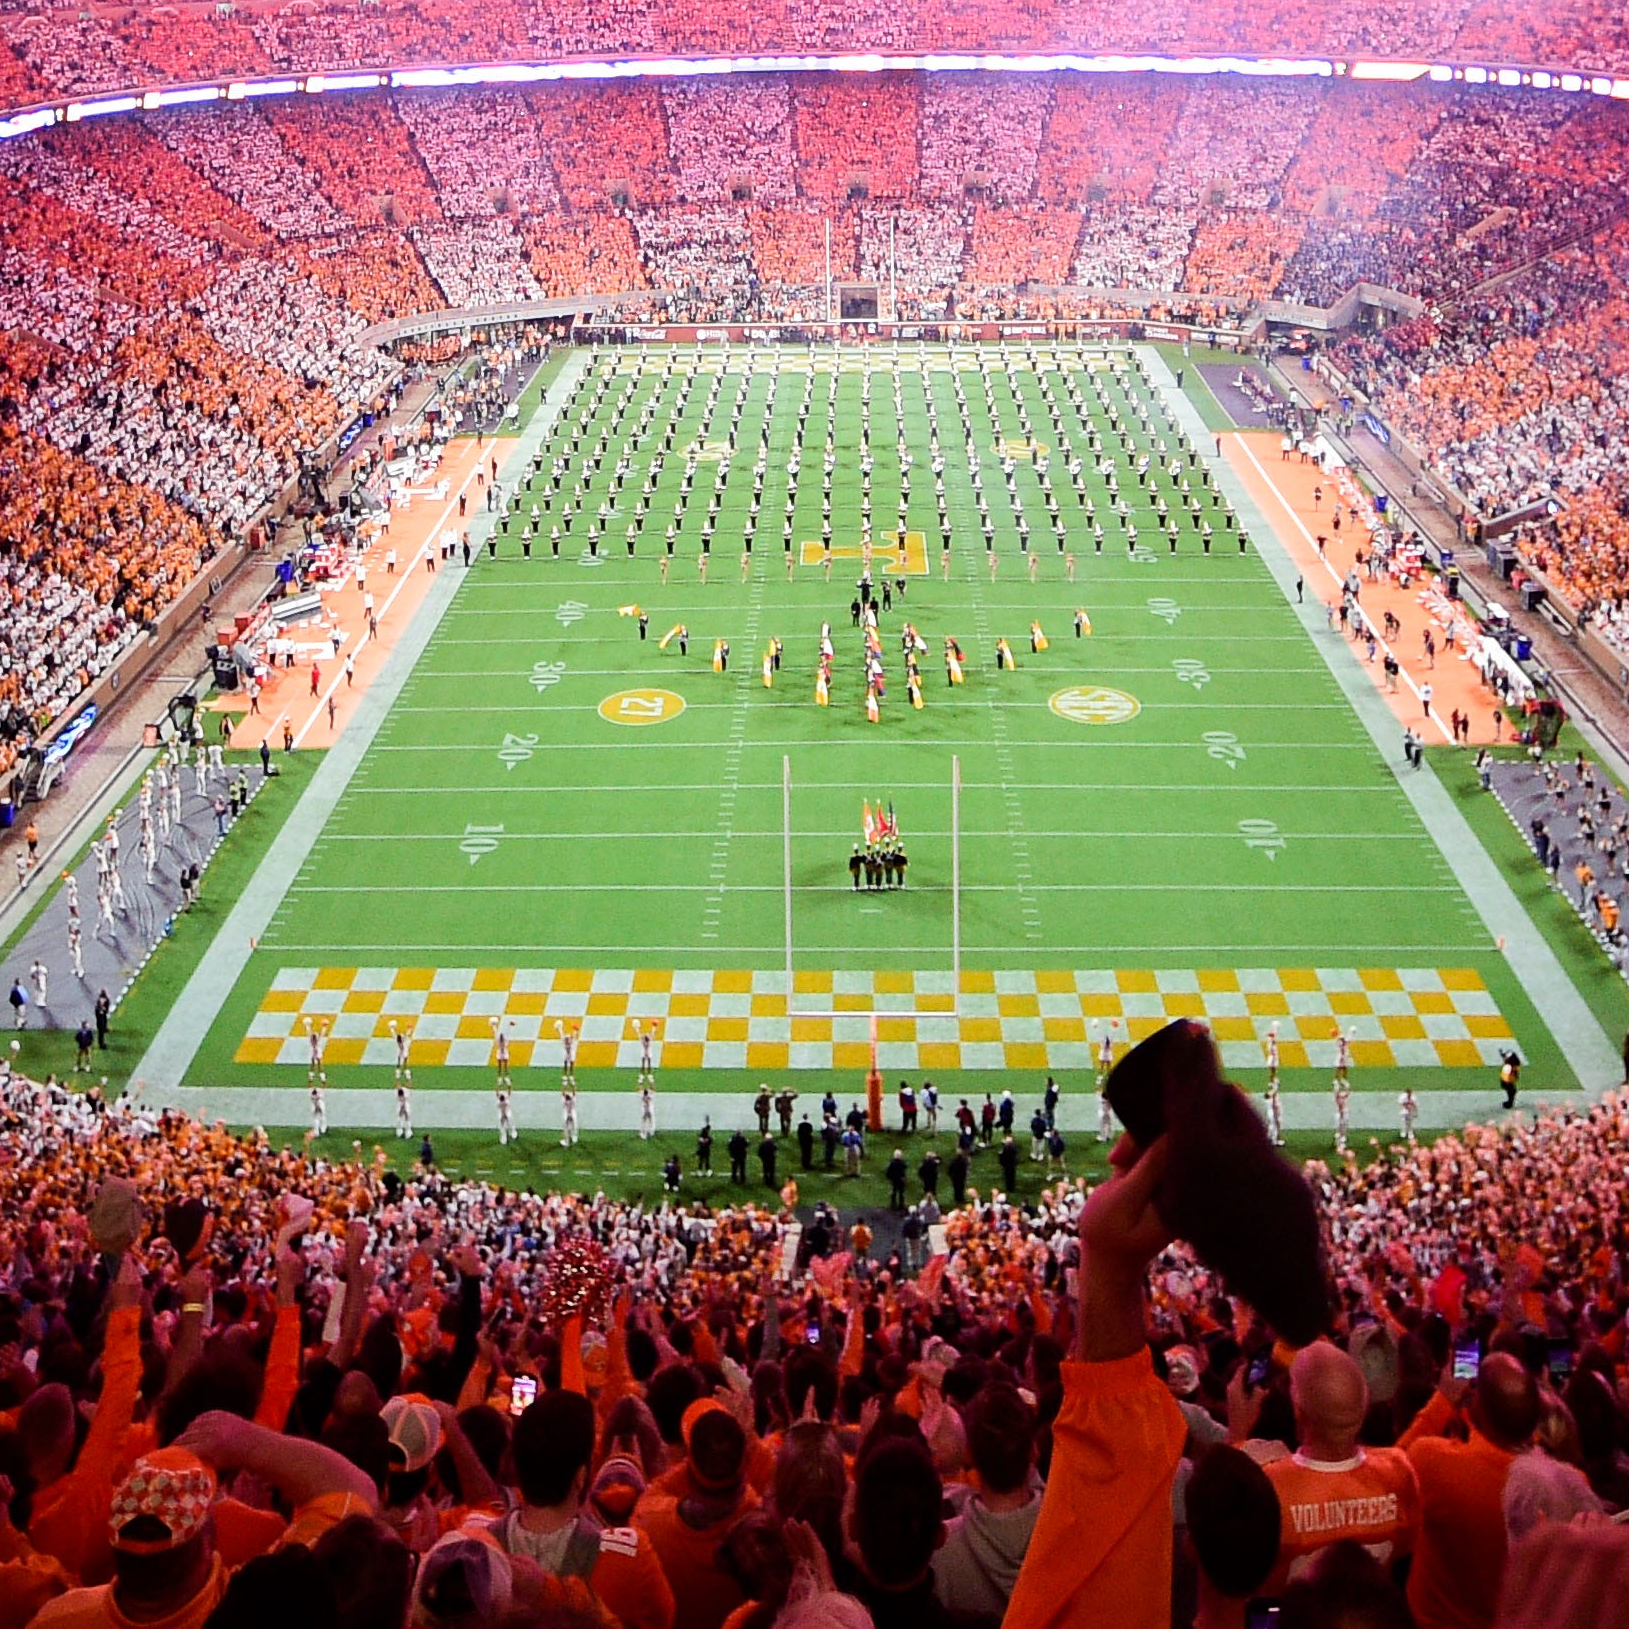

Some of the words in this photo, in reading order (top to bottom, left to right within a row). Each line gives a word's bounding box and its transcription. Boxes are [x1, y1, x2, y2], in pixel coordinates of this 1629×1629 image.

[555, 600, 588, 621] 40
[1147, 598, 1181, 619] 40
[529, 661, 566, 685] 30
[1172, 658, 1211, 682] 30
[619, 697, 664, 717] 27
[498, 733, 539, 761] 20
[1202, 731, 1247, 759] 20
[459, 823, 504, 853] 10
[1237, 819, 1287, 849] 10
[1290, 1492, 1397, 1533] VOLUNTEERS
